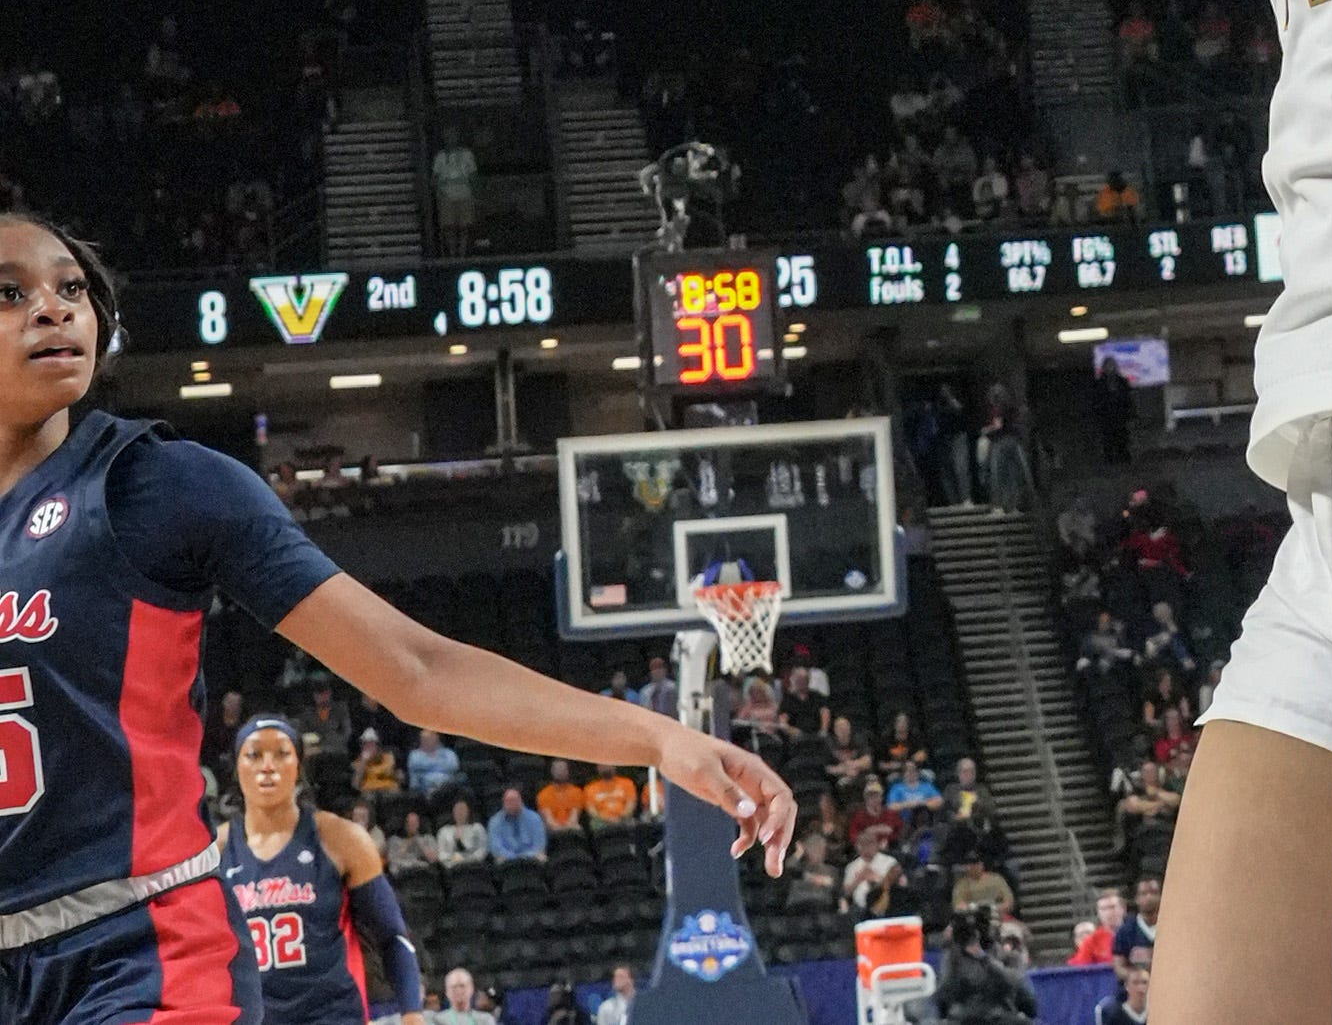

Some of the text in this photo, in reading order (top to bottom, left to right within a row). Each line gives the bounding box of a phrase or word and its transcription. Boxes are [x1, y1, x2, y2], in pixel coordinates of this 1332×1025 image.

[944, 242, 961, 271] 4
[1160, 255, 1176, 281] 2
[249, 272, 350, 344] V
[366, 275, 416, 311] 2nd
[457, 267, 554, 326] 8:58
[681, 270, 761, 312] 8:58
[869, 272, 962, 305] Fouls 2
[199, 290, 228, 344] 8
[676, 314, 755, 384] 30
[28, 500, 66, 536] SEC
[246, 912, 307, 972] 32
